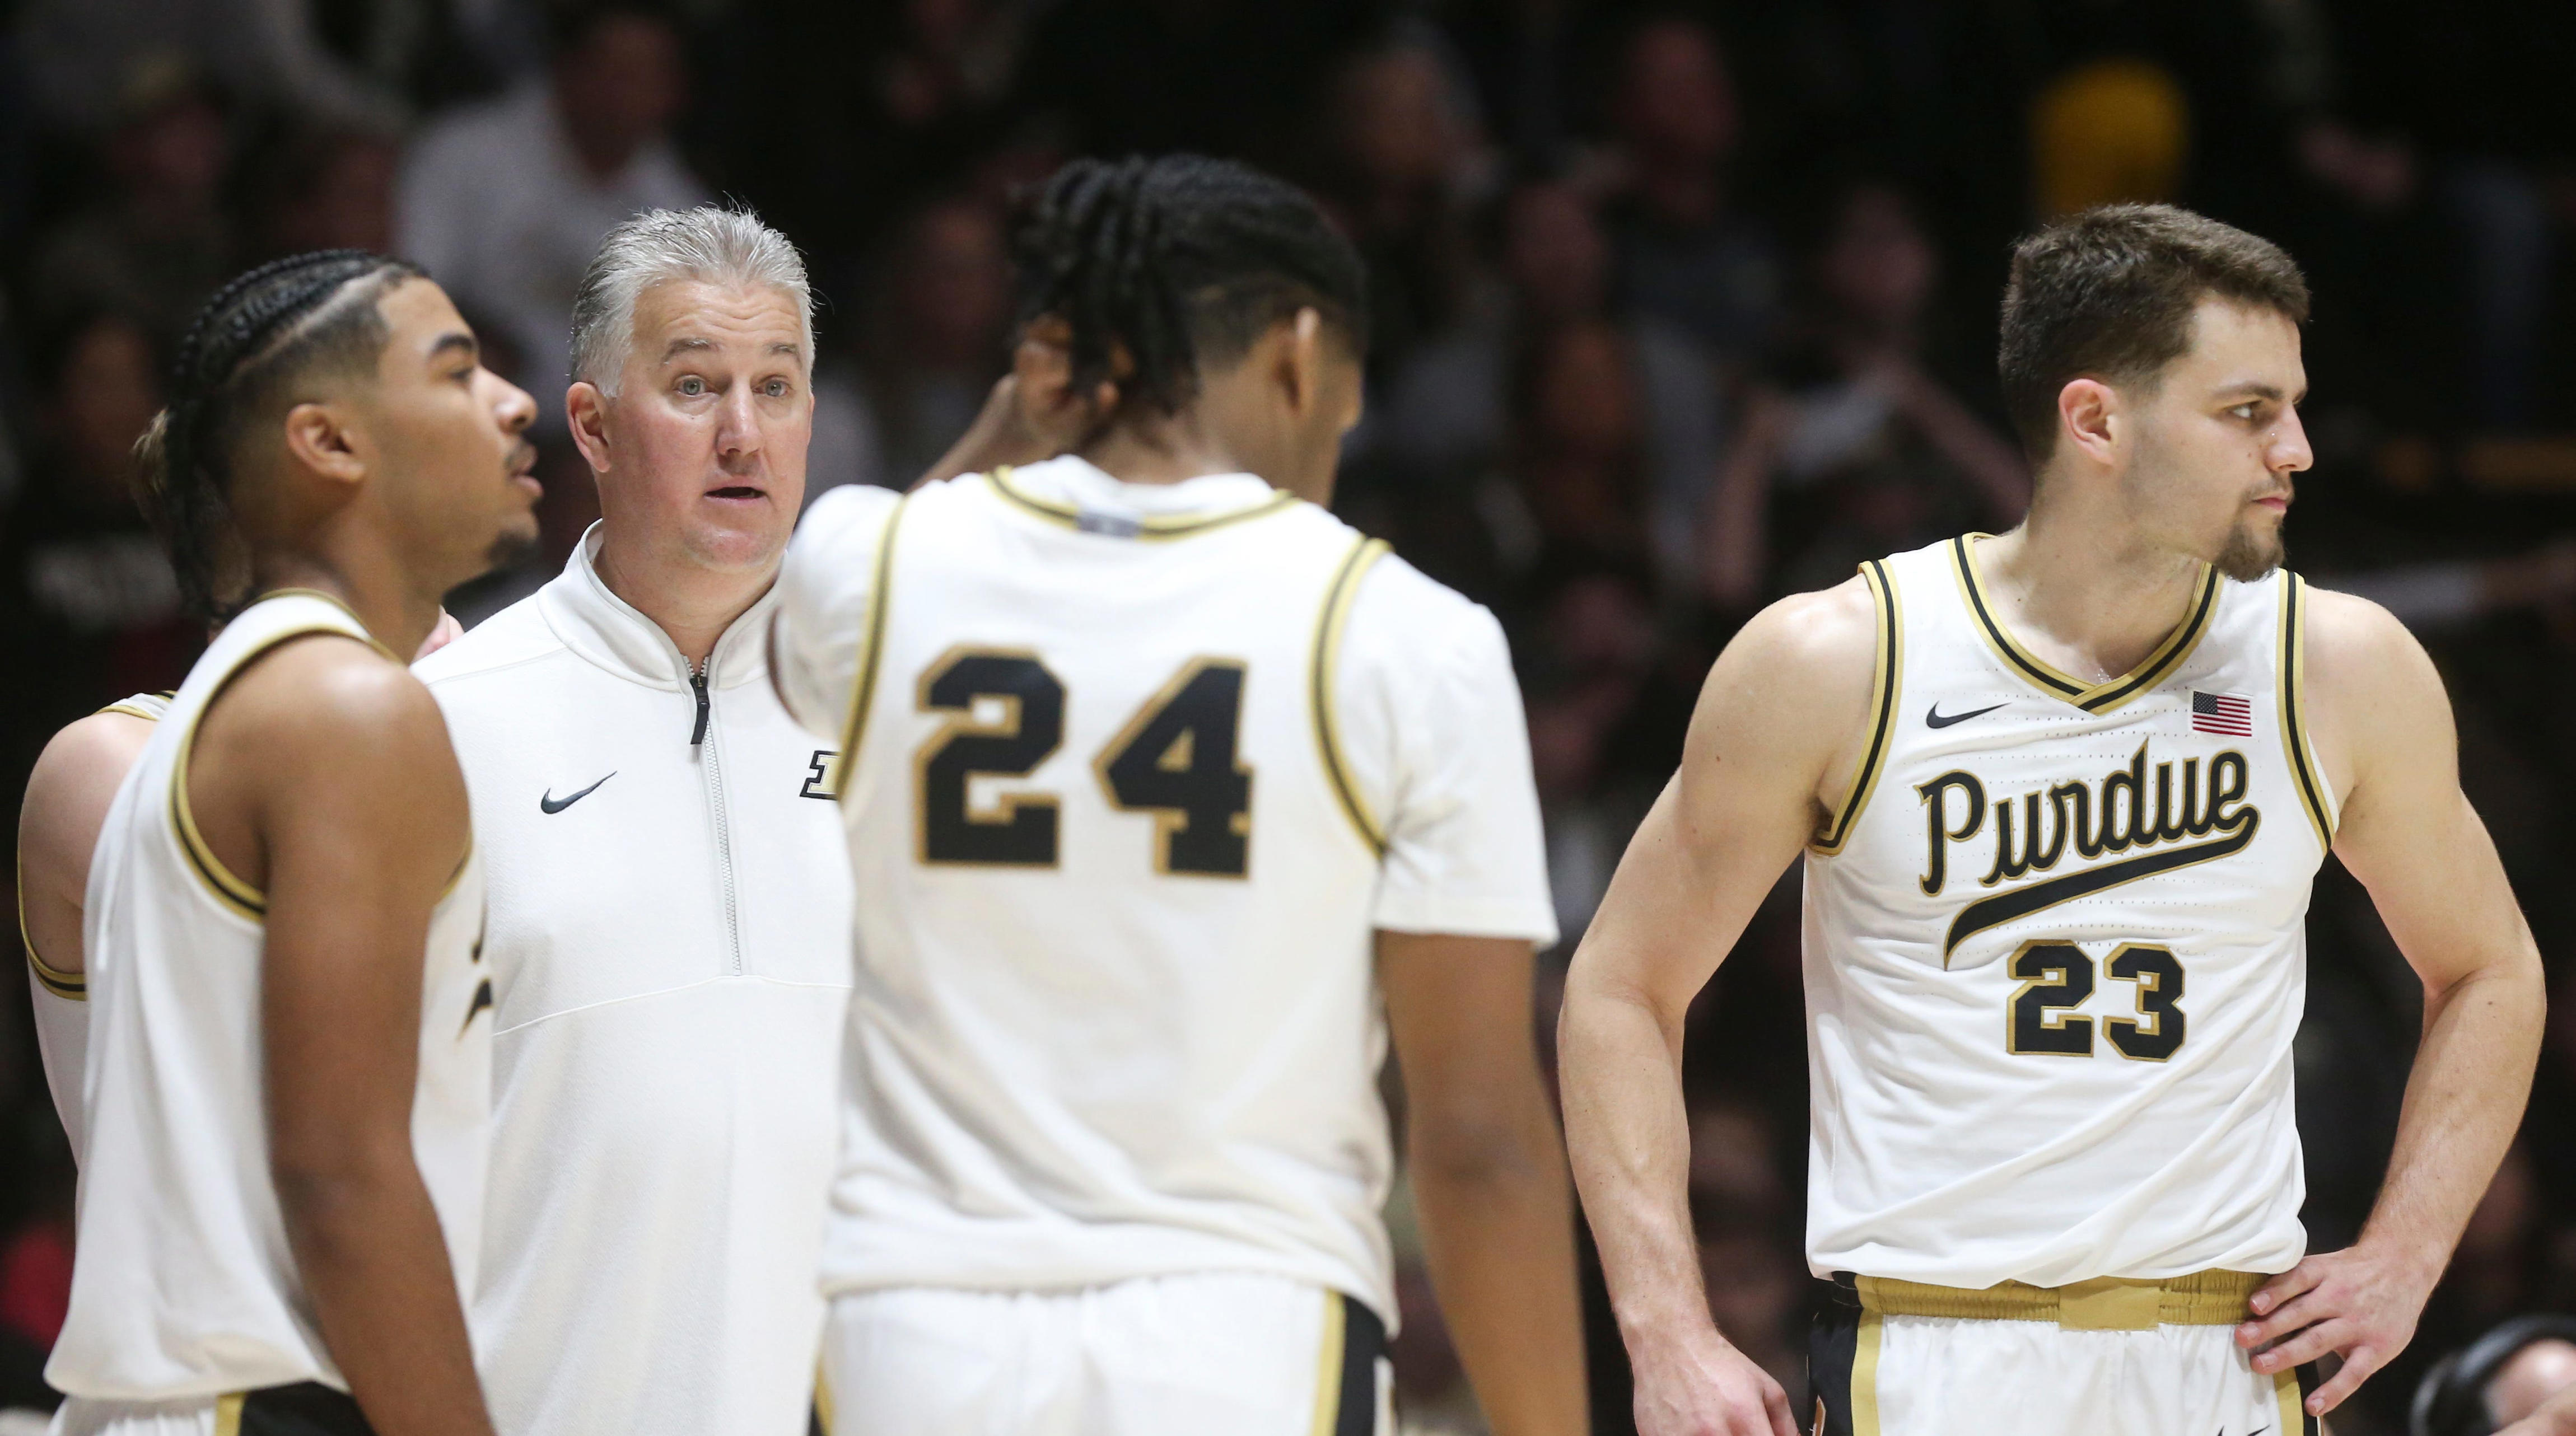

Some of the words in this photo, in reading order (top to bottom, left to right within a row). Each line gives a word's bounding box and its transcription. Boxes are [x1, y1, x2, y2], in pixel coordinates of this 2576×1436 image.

[913, 643, 1254, 880] 24
[1913, 736, 2261, 897] Purdue
[2006, 939, 2187, 1063] 23
